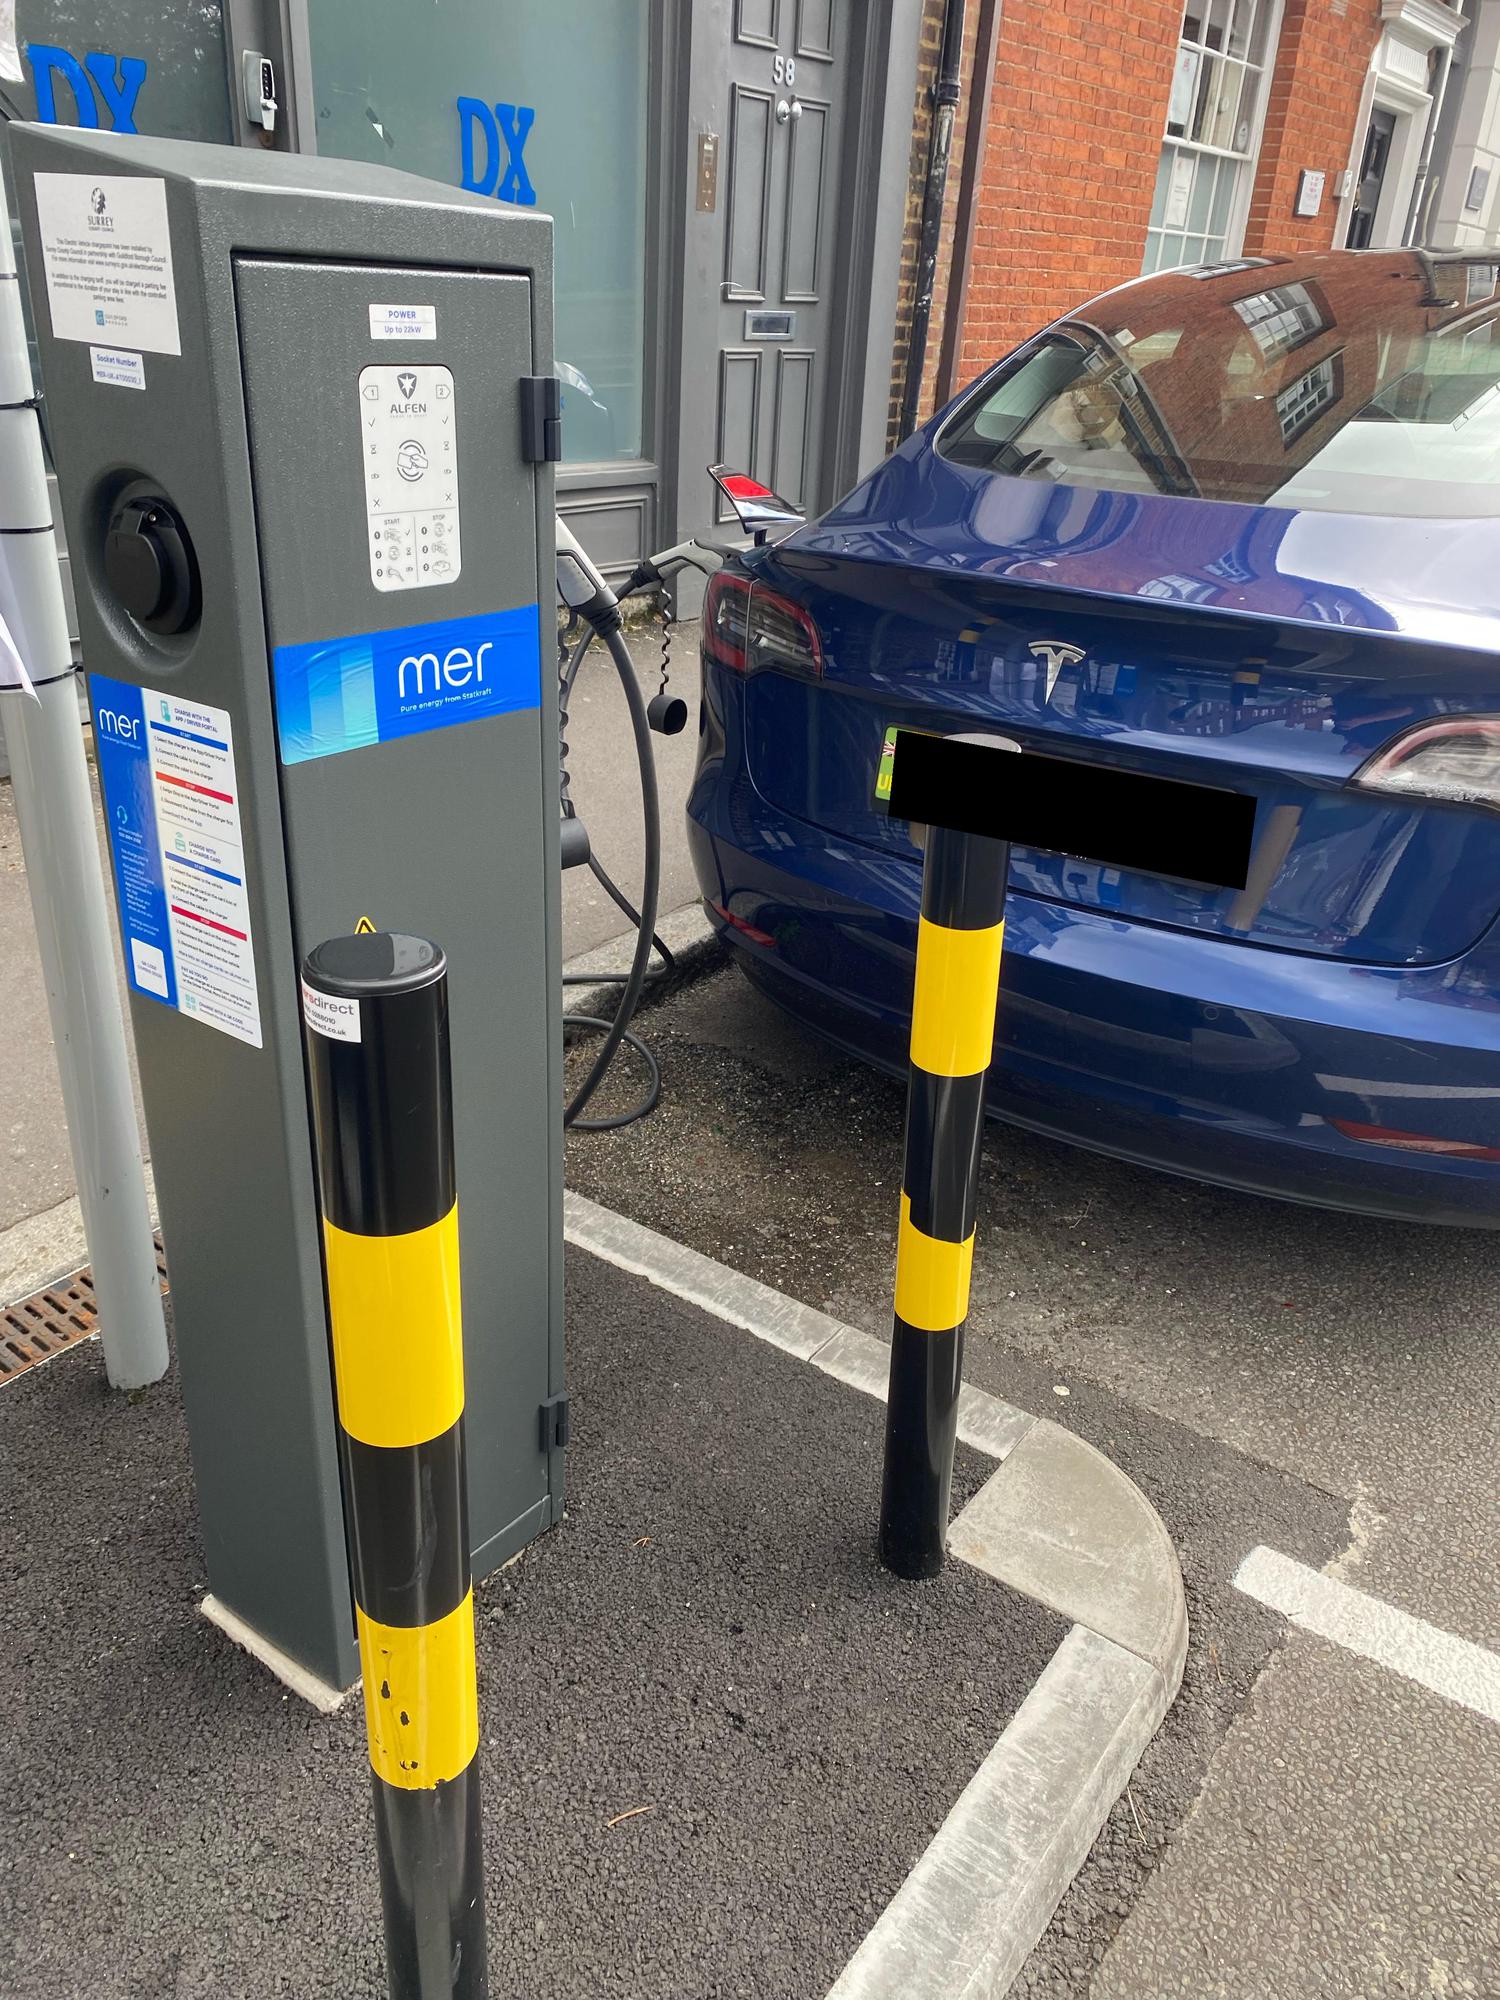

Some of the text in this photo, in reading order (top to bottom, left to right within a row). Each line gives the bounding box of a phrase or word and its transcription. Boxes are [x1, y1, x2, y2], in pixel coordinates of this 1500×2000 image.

[773, 55, 795, 87] 58
[26, 44, 147, 135] DX
[457, 96, 536, 206] DX
[87, 215, 114, 227] SURREY
[388, 310, 416, 319] POWER
[385, 326, 394, 334] Up
[97, 353, 137, 368] Socket Number
[390, 404, 427, 413] ALFEN
[399, 642, 493, 698] mer
[400, 688, 492, 713] Pure energy from Statkraft
[99, 708, 140, 740] mer
[877, 772, 893, 791] U
